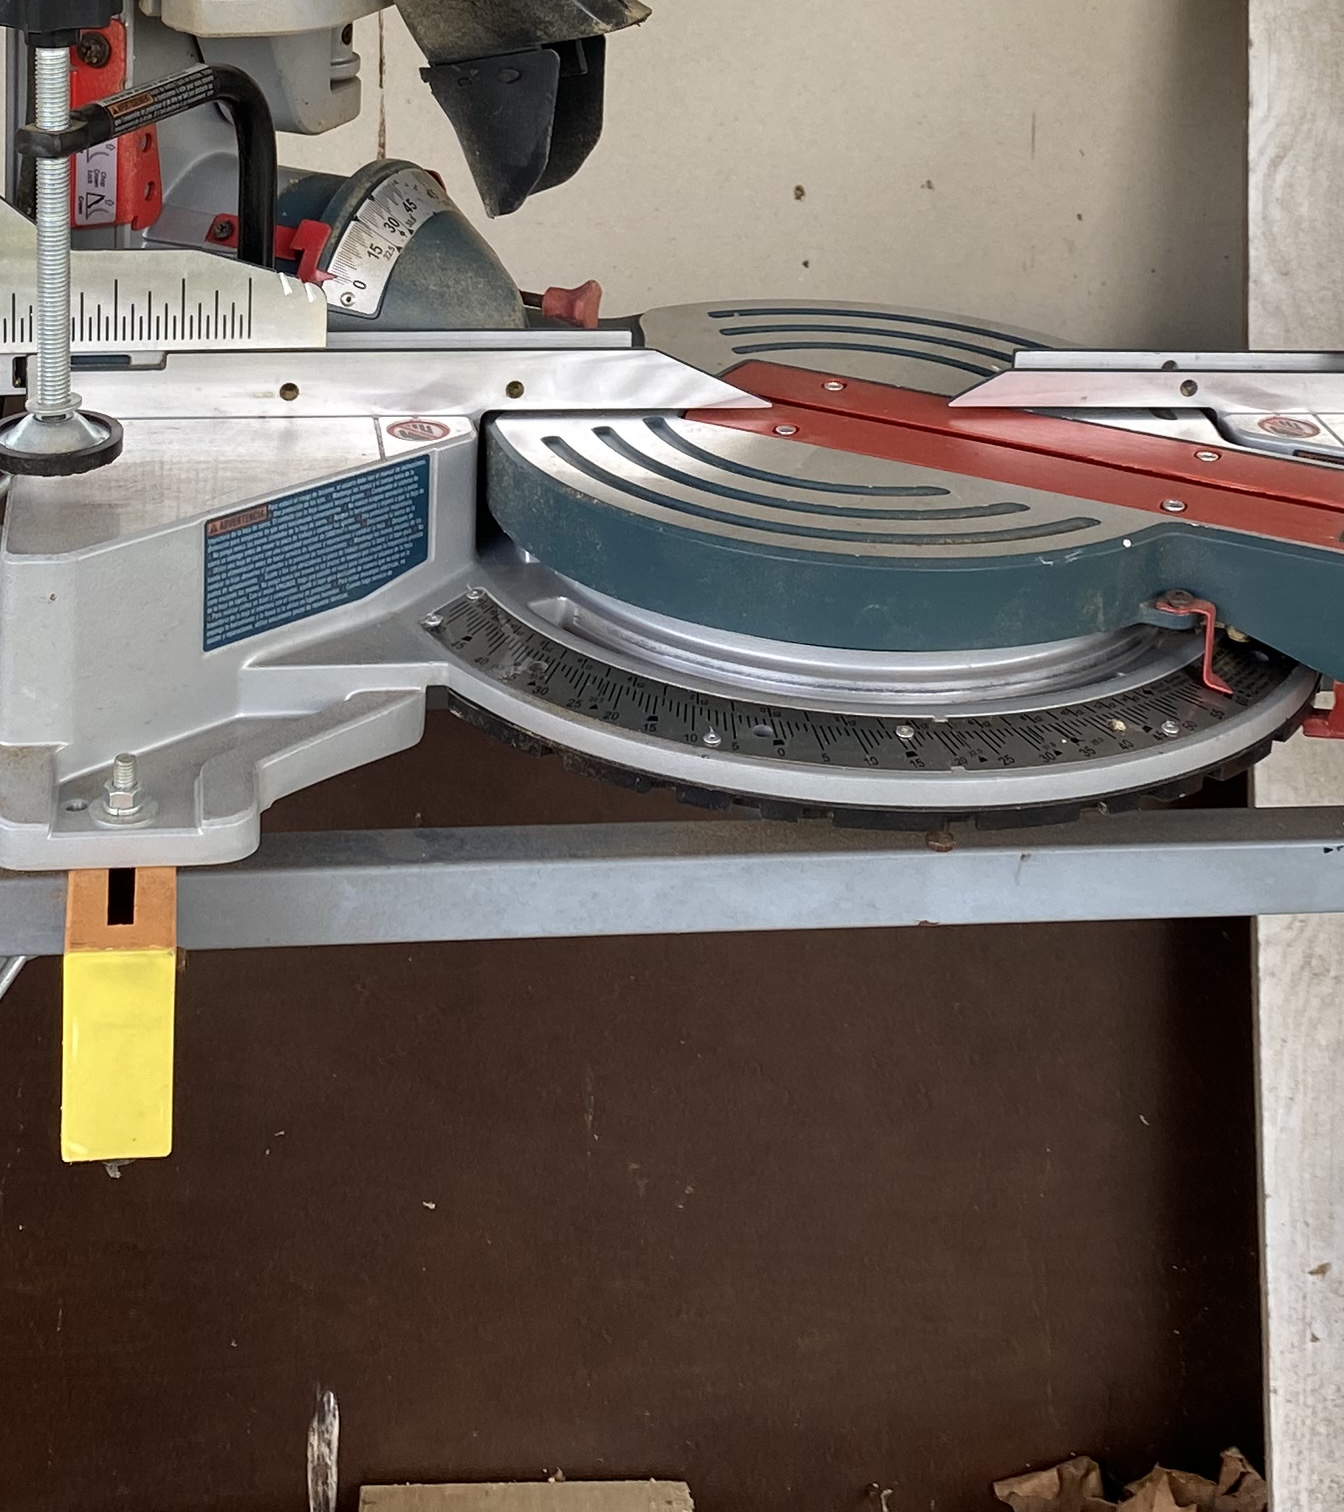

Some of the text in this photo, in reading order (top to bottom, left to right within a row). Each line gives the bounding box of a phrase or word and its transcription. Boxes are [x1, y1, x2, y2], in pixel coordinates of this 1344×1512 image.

[402, 197, 418, 214] 45
[383, 216, 400, 234] 30
[367, 243, 384, 260] 15
[352, 279, 367, 290] 0
[531, 686, 550, 697] 30
[566, 697, 584, 709] 25
[603, 710, 620, 721] 20
[643, 721, 657, 733] 15
[684, 732, 699, 744] 10
[731, 740, 740, 752] 5
[1118, 738, 1135, 751] 40
[776, 746, 787, 757] 0
[821, 752, 831, 763] 5
[1039, 750, 1056, 764] 30
[1078, 746, 1097, 758] 35
[863, 756, 879, 767] 10
[909, 758, 926, 769] 15
[955, 756, 968, 767] 20
[997, 753, 1016, 767] 25
